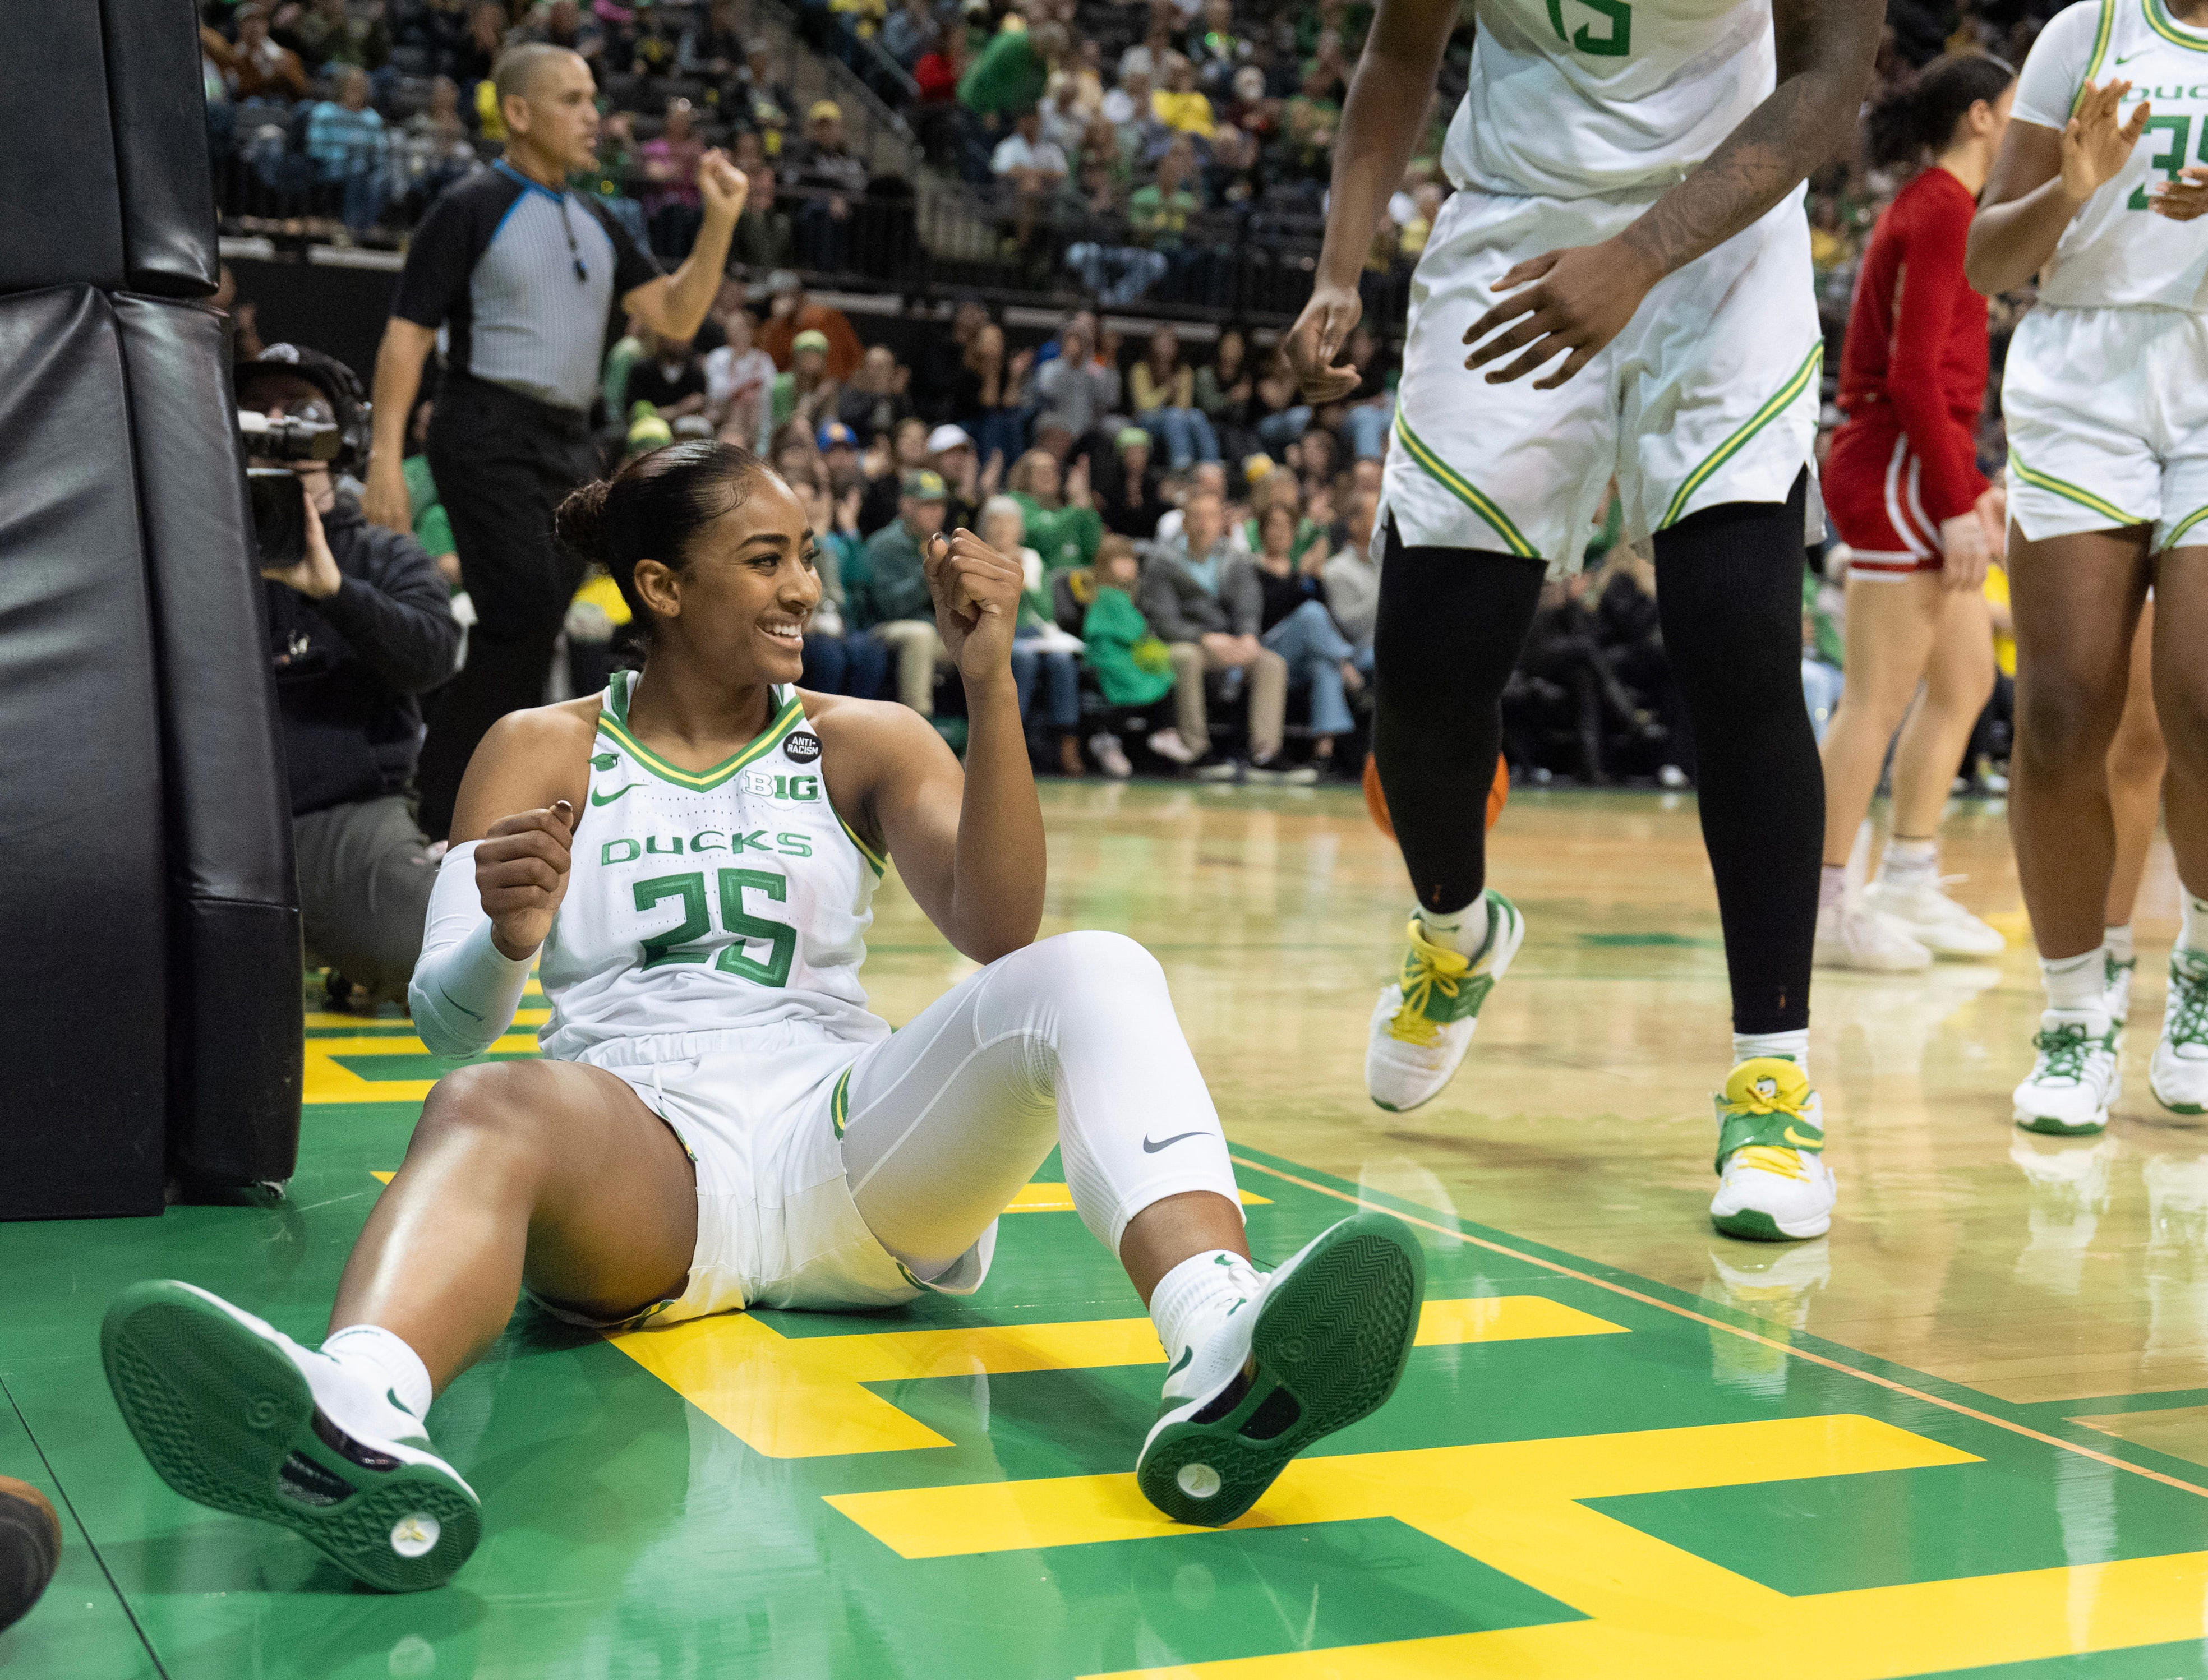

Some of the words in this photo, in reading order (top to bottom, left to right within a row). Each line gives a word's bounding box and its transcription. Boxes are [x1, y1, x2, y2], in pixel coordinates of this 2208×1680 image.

[2127, 115, 2208, 210] 3
[787, 744, 818, 755] RACISM
[792, 736, 816, 746] ANTI-
[602, 830, 812, 866] DUCKS
[633, 868, 797, 988] 25
